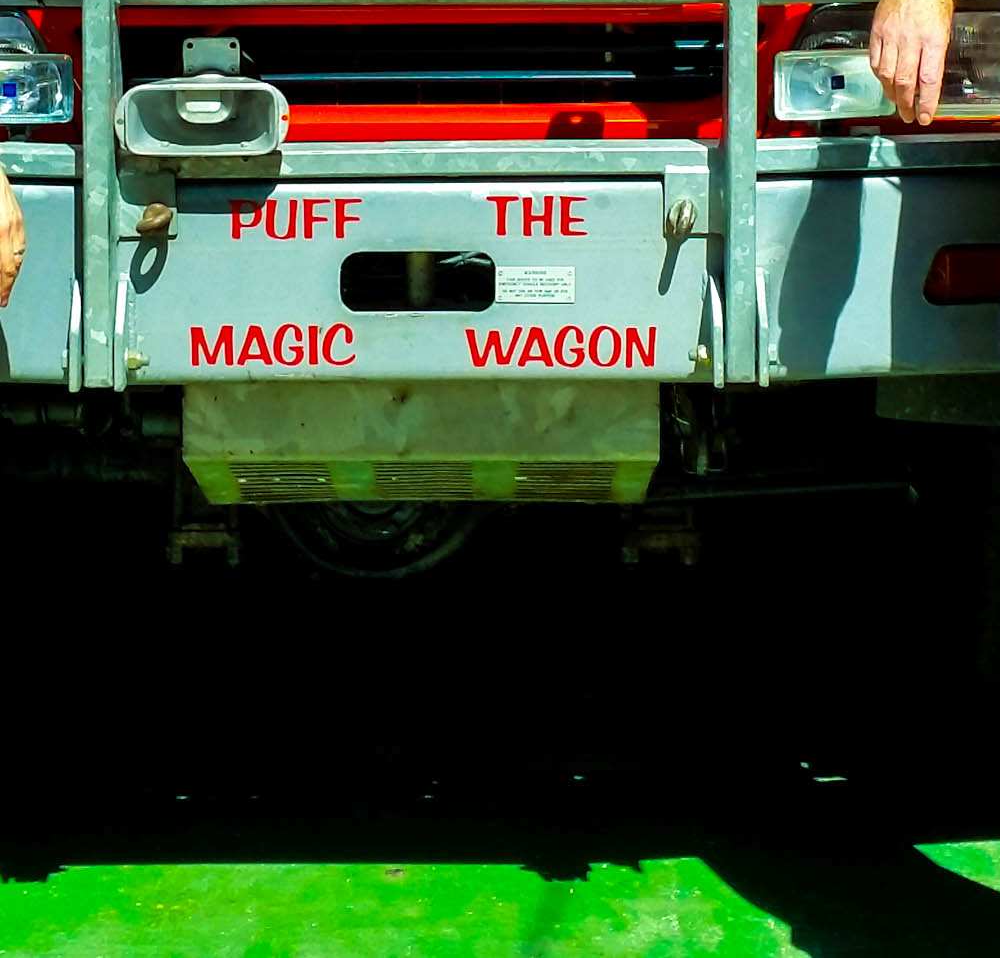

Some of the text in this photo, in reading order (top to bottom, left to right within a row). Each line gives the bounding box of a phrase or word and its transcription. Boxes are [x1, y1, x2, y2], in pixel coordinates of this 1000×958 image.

[229, 195, 588, 240] PUFF THE
[190, 323, 657, 368] MAGIC WAGON
